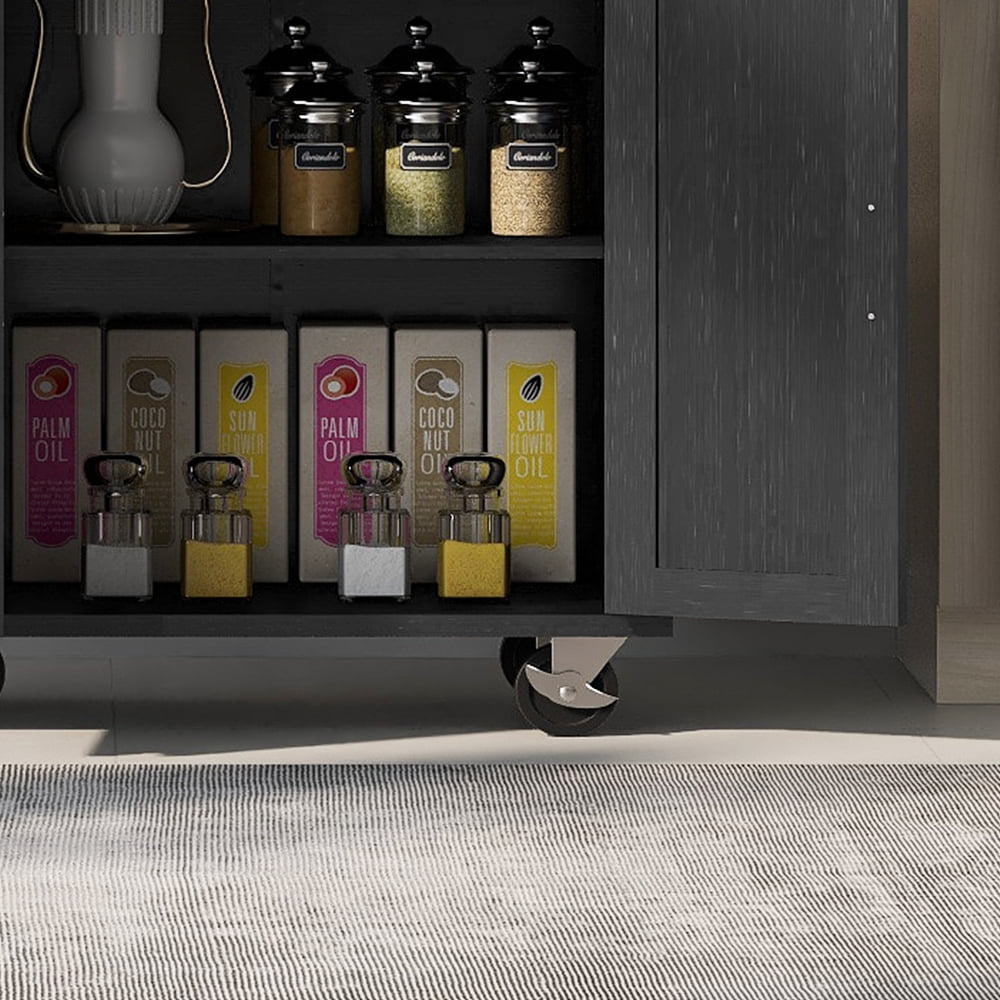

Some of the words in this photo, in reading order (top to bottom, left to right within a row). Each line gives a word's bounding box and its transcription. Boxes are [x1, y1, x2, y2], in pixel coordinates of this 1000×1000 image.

[32, 417, 70, 439] PALM
[131, 407, 166, 428] COCO
[229, 410, 257, 432] SUN
[321, 417, 358, 439] PALM
[419, 407, 454, 428] COCO
[518, 410, 545, 432] SUN
[35, 440, 69, 462] OIL
[135, 430, 162, 451] NUT
[221, 433, 264, 454] FLOWER
[424, 430, 450, 451] NUT
[510, 433, 553, 454] FLOWER
[421, 453, 441, 475] OI
[515, 456, 549, 478] OIL
